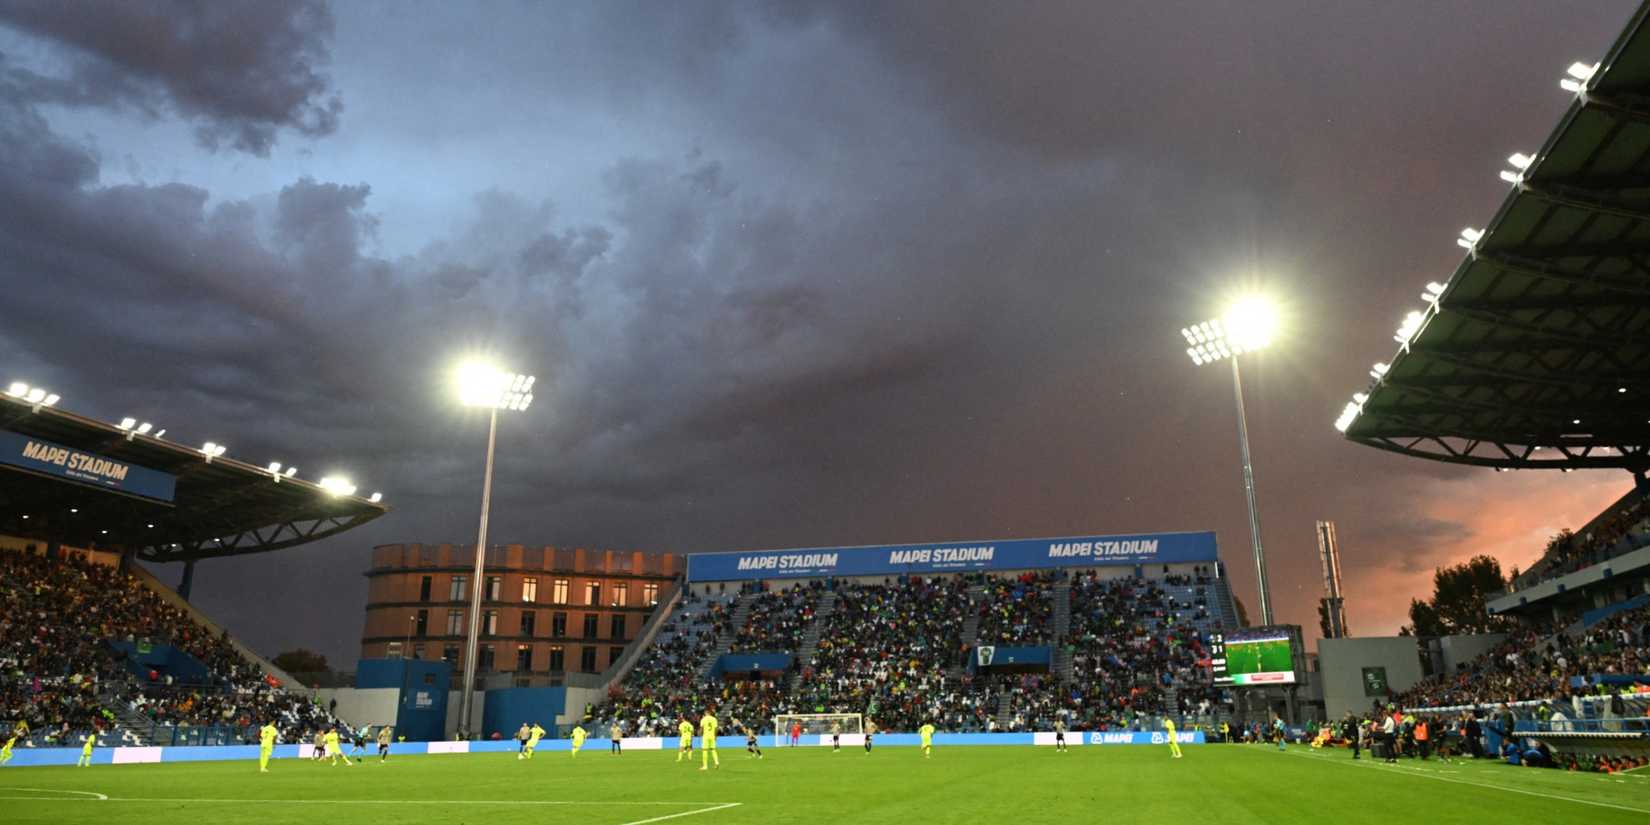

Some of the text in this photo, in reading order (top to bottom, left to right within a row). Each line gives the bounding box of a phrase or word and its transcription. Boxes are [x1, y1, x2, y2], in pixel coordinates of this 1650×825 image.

[22, 441, 69, 466] MAPEI
[68, 452, 129, 481] STADIUM
[889, 546, 994, 564] MAPEI STADIUM
[1048, 539, 1159, 557] MAPEI STADIUM
[737, 553, 838, 570] MAPEI STADIUM
[1103, 732, 1133, 744] MAPEI
